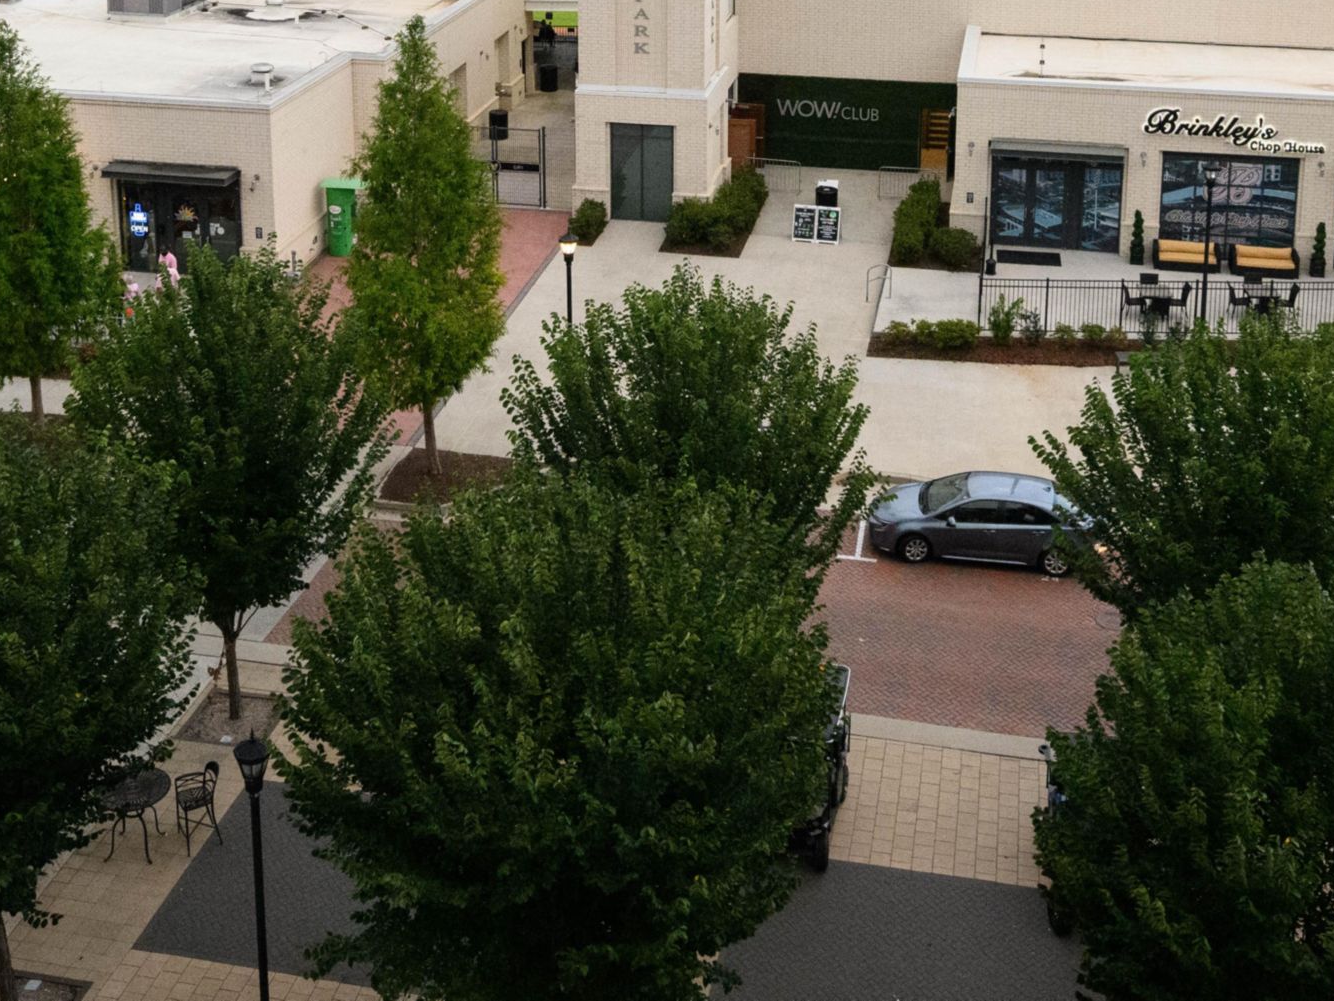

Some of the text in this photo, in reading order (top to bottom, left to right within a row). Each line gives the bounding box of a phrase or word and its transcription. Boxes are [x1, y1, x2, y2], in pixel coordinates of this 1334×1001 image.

[776, 98, 880, 122] WOW! CLUB
[1143, 108, 1279, 146] Brinkley's
[1249, 140, 1326, 155] Chop House
[130, 224, 149, 233] OPEN
